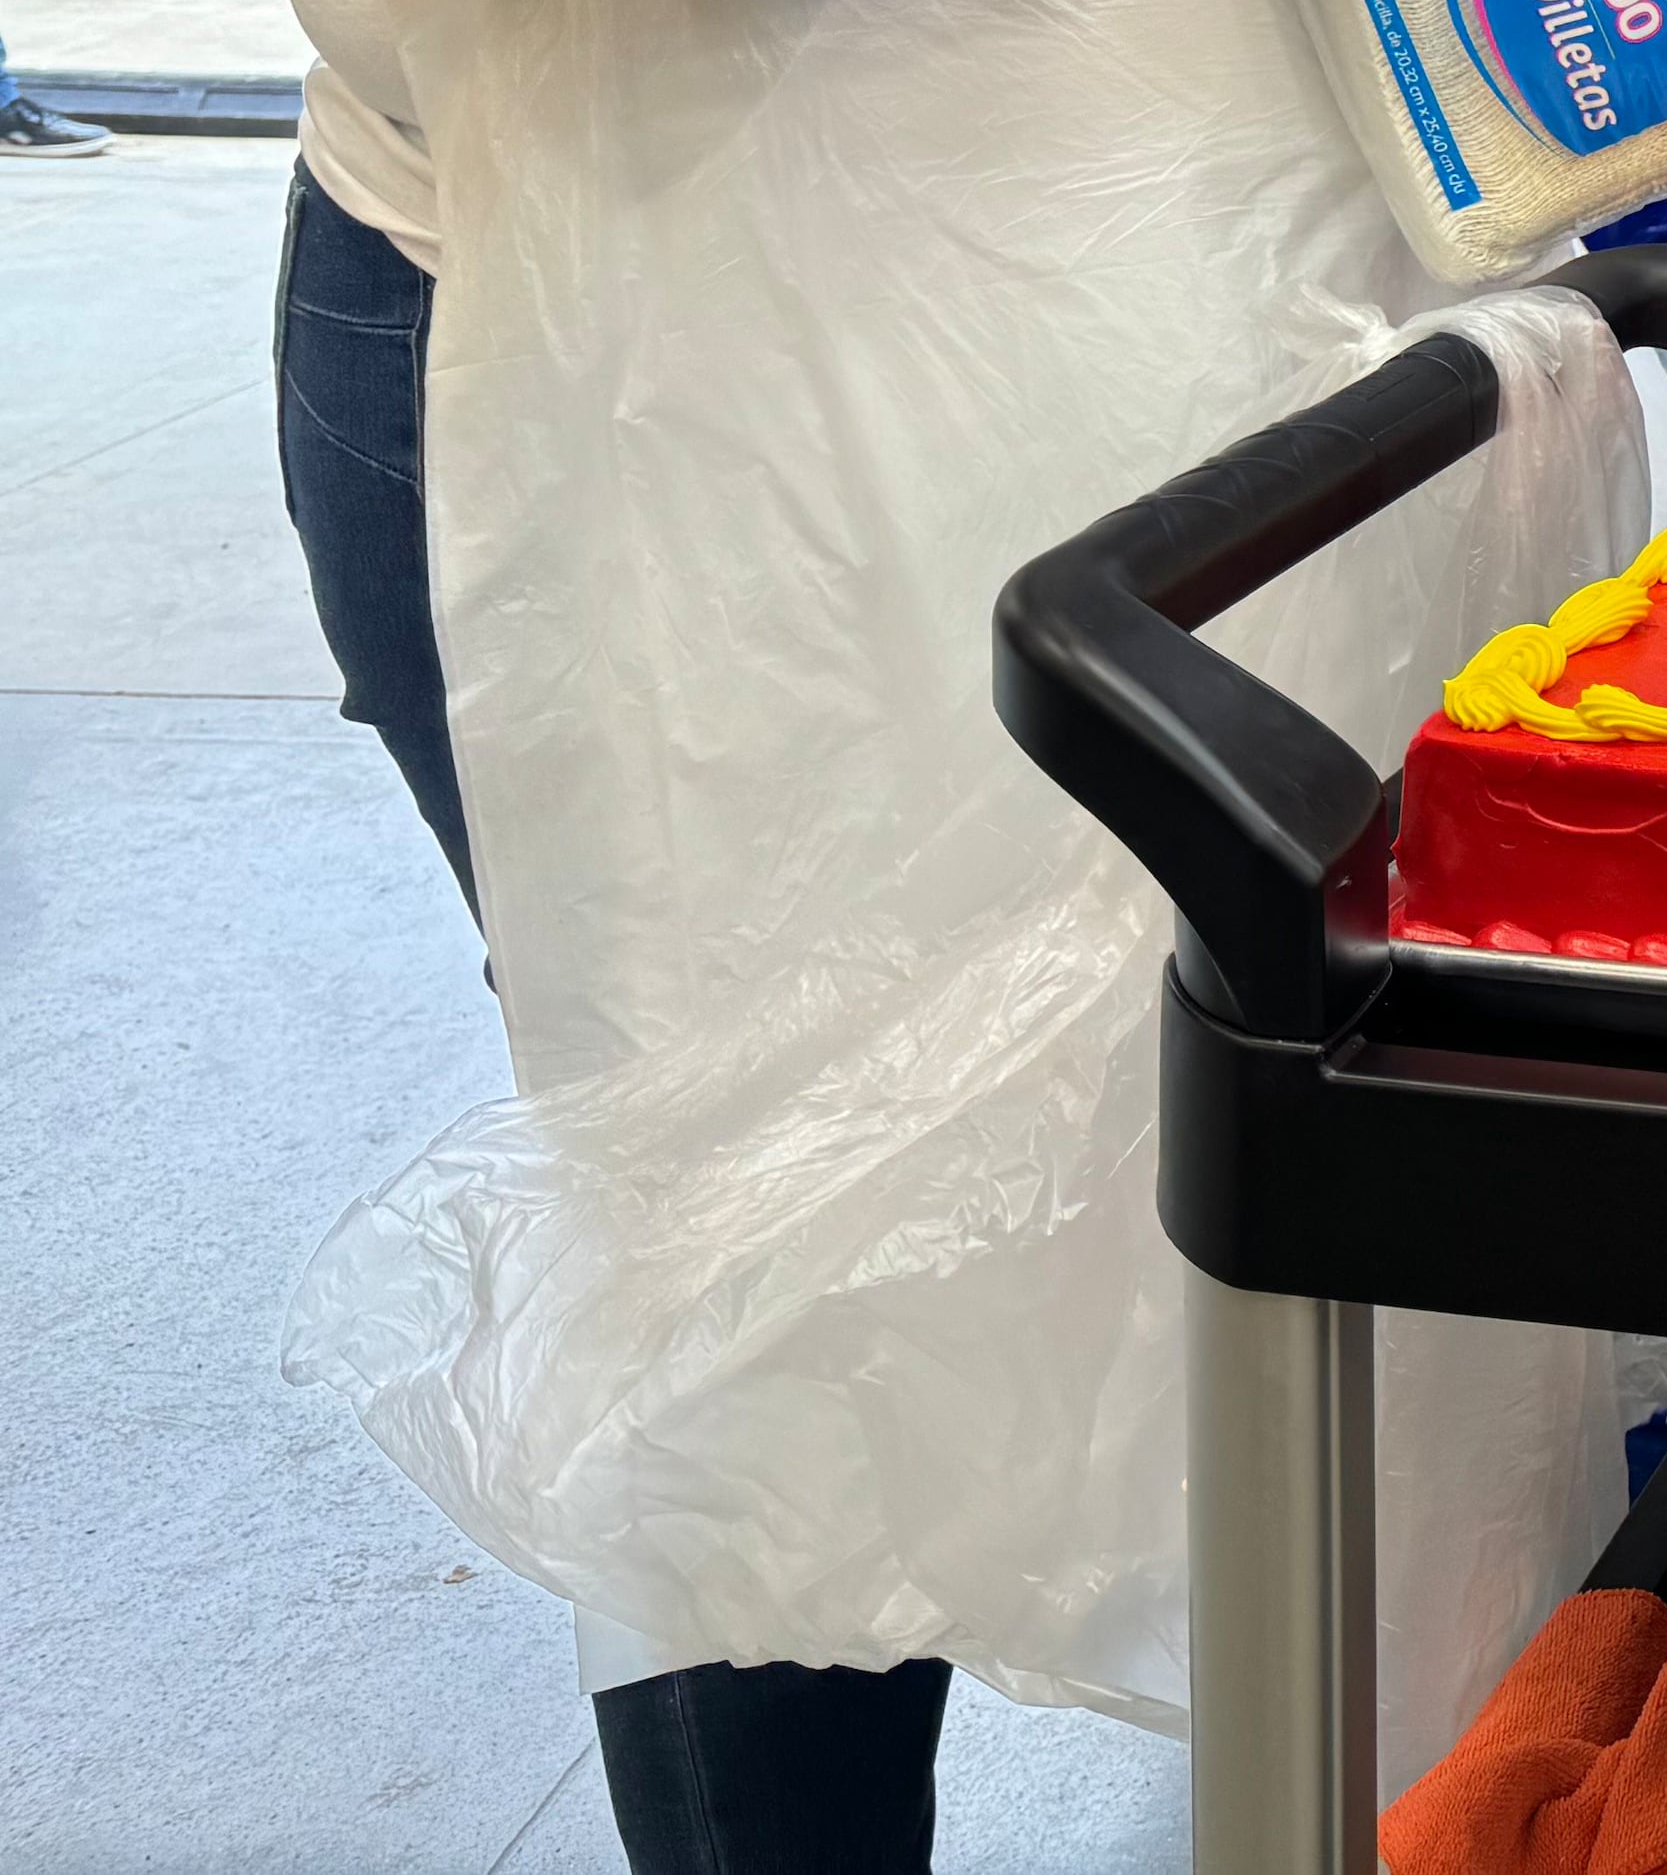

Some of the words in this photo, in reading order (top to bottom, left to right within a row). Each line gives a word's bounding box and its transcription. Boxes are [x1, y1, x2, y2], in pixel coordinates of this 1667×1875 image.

[1386, 29, 1402, 50] de
[1393, 48, 1420, 87] 20,32
[1408, 85, 1424, 107] cm
[1418, 107, 1429, 118] x
[1422, 116, 1448, 153] 25,40
[1437, 151, 1456, 174] cm
[1447, 172, 1466, 195] c/u
